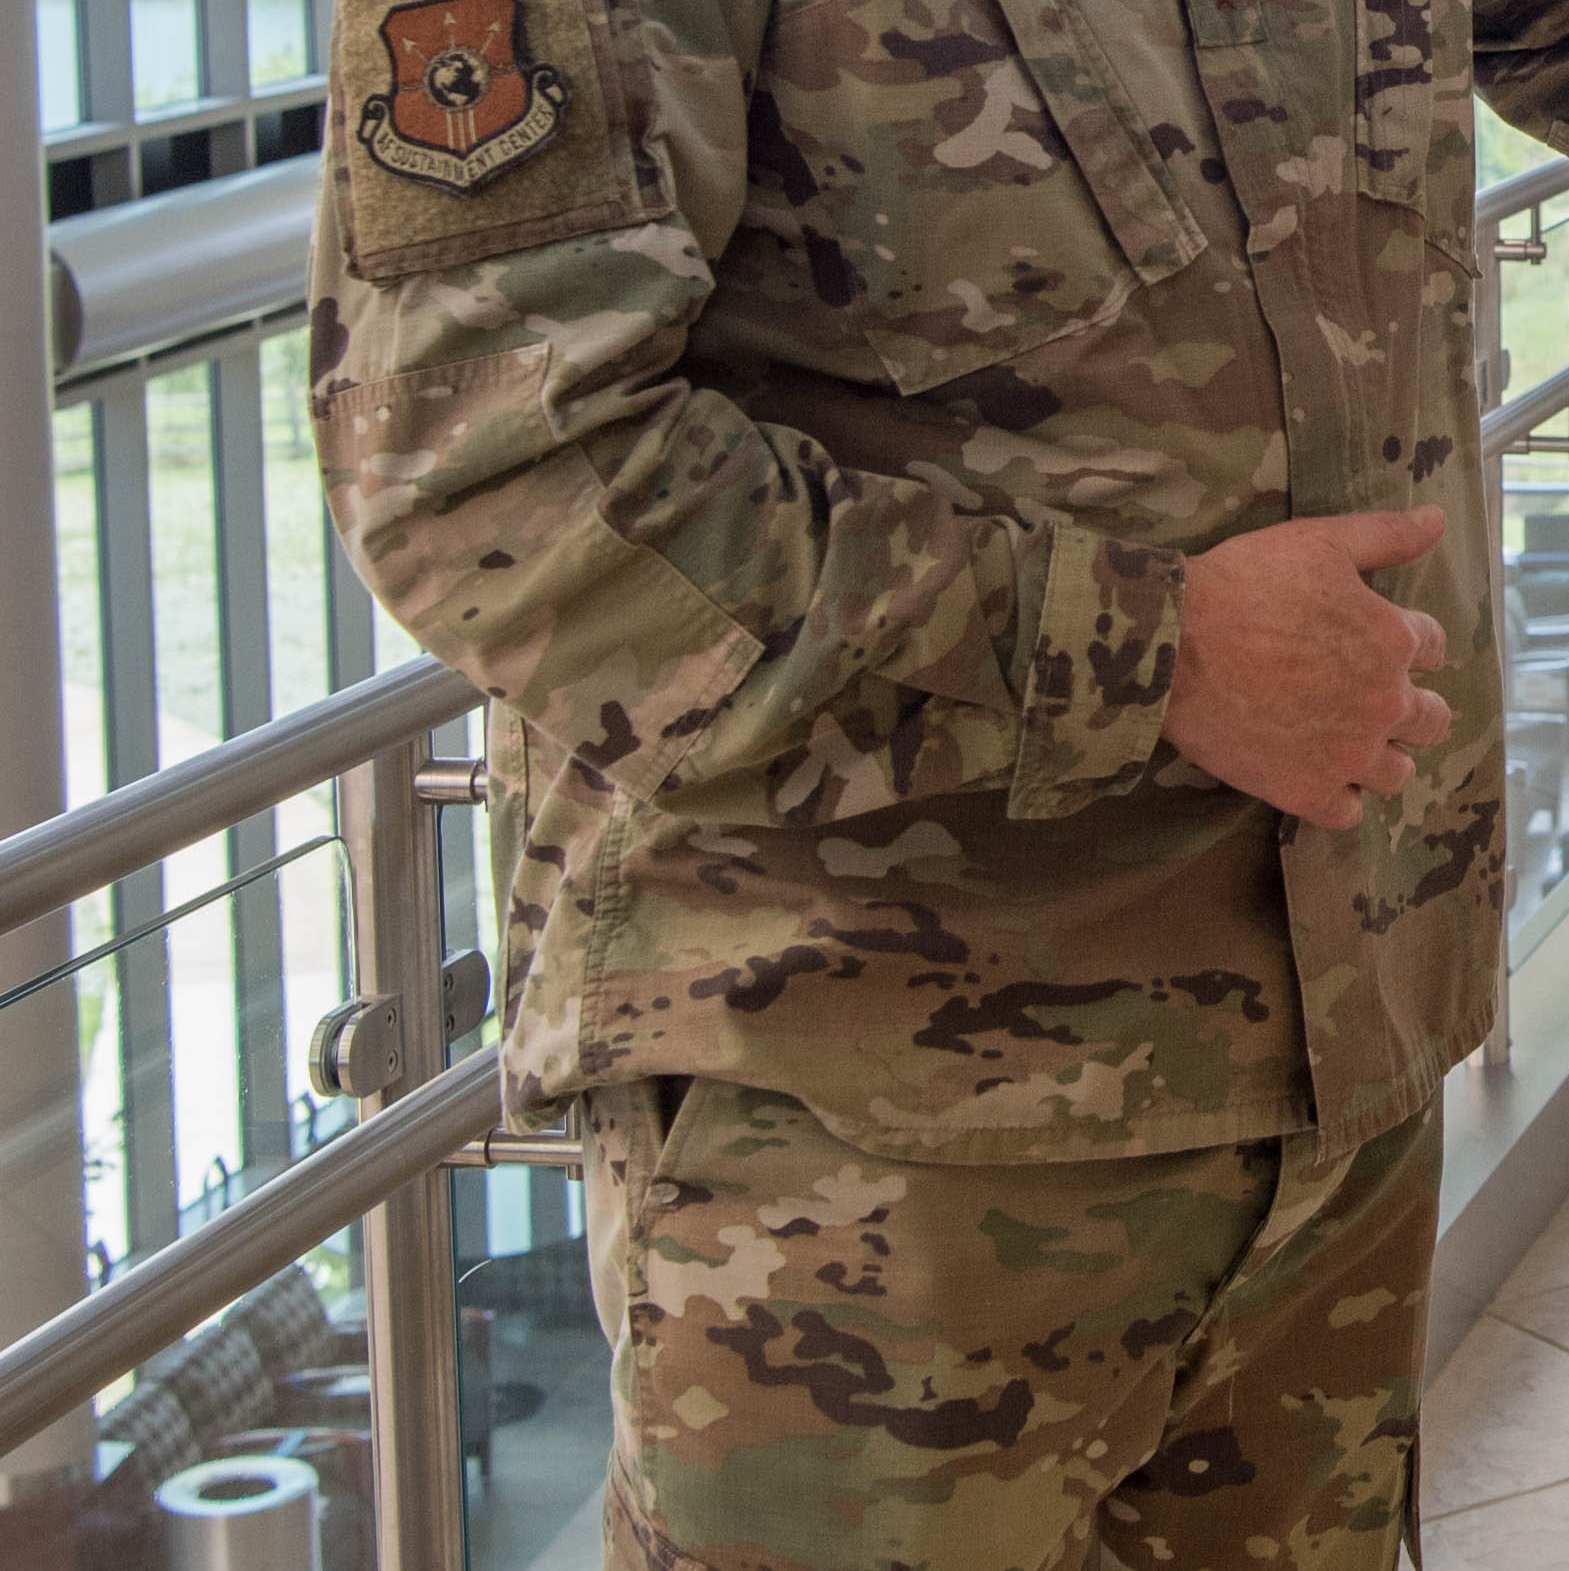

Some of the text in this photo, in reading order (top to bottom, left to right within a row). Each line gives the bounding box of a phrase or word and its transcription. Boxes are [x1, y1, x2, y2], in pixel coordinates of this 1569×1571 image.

[376, 106, 554, 179] AF SUSTAINMENT CENTER
